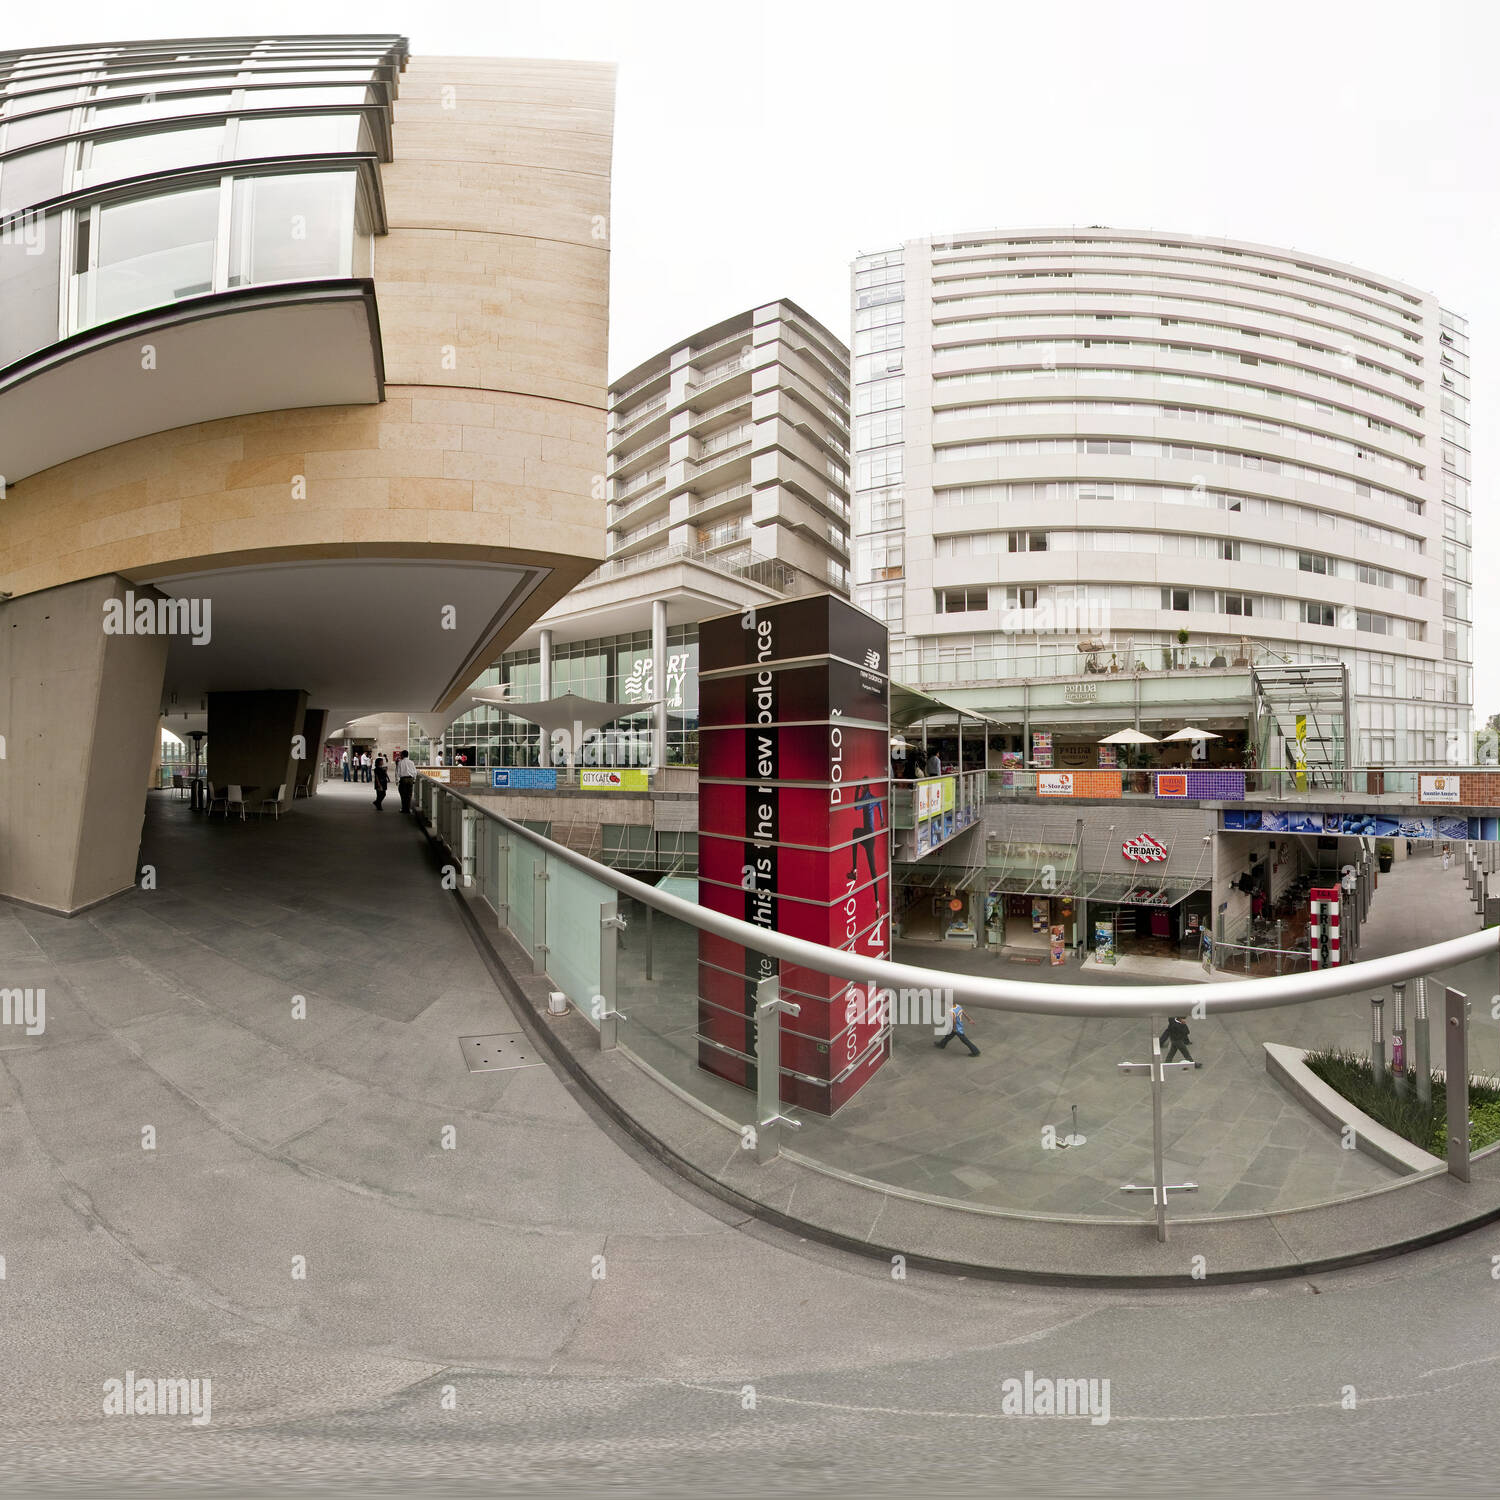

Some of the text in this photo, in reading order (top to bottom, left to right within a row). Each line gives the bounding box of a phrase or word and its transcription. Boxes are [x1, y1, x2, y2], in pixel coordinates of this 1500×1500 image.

[632, 653, 690, 678] SPRT
[752, 620, 772, 728] balance
[645, 672, 687, 694] CTY
[753, 803, 773, 849] the
[756, 857, 772, 879] is
